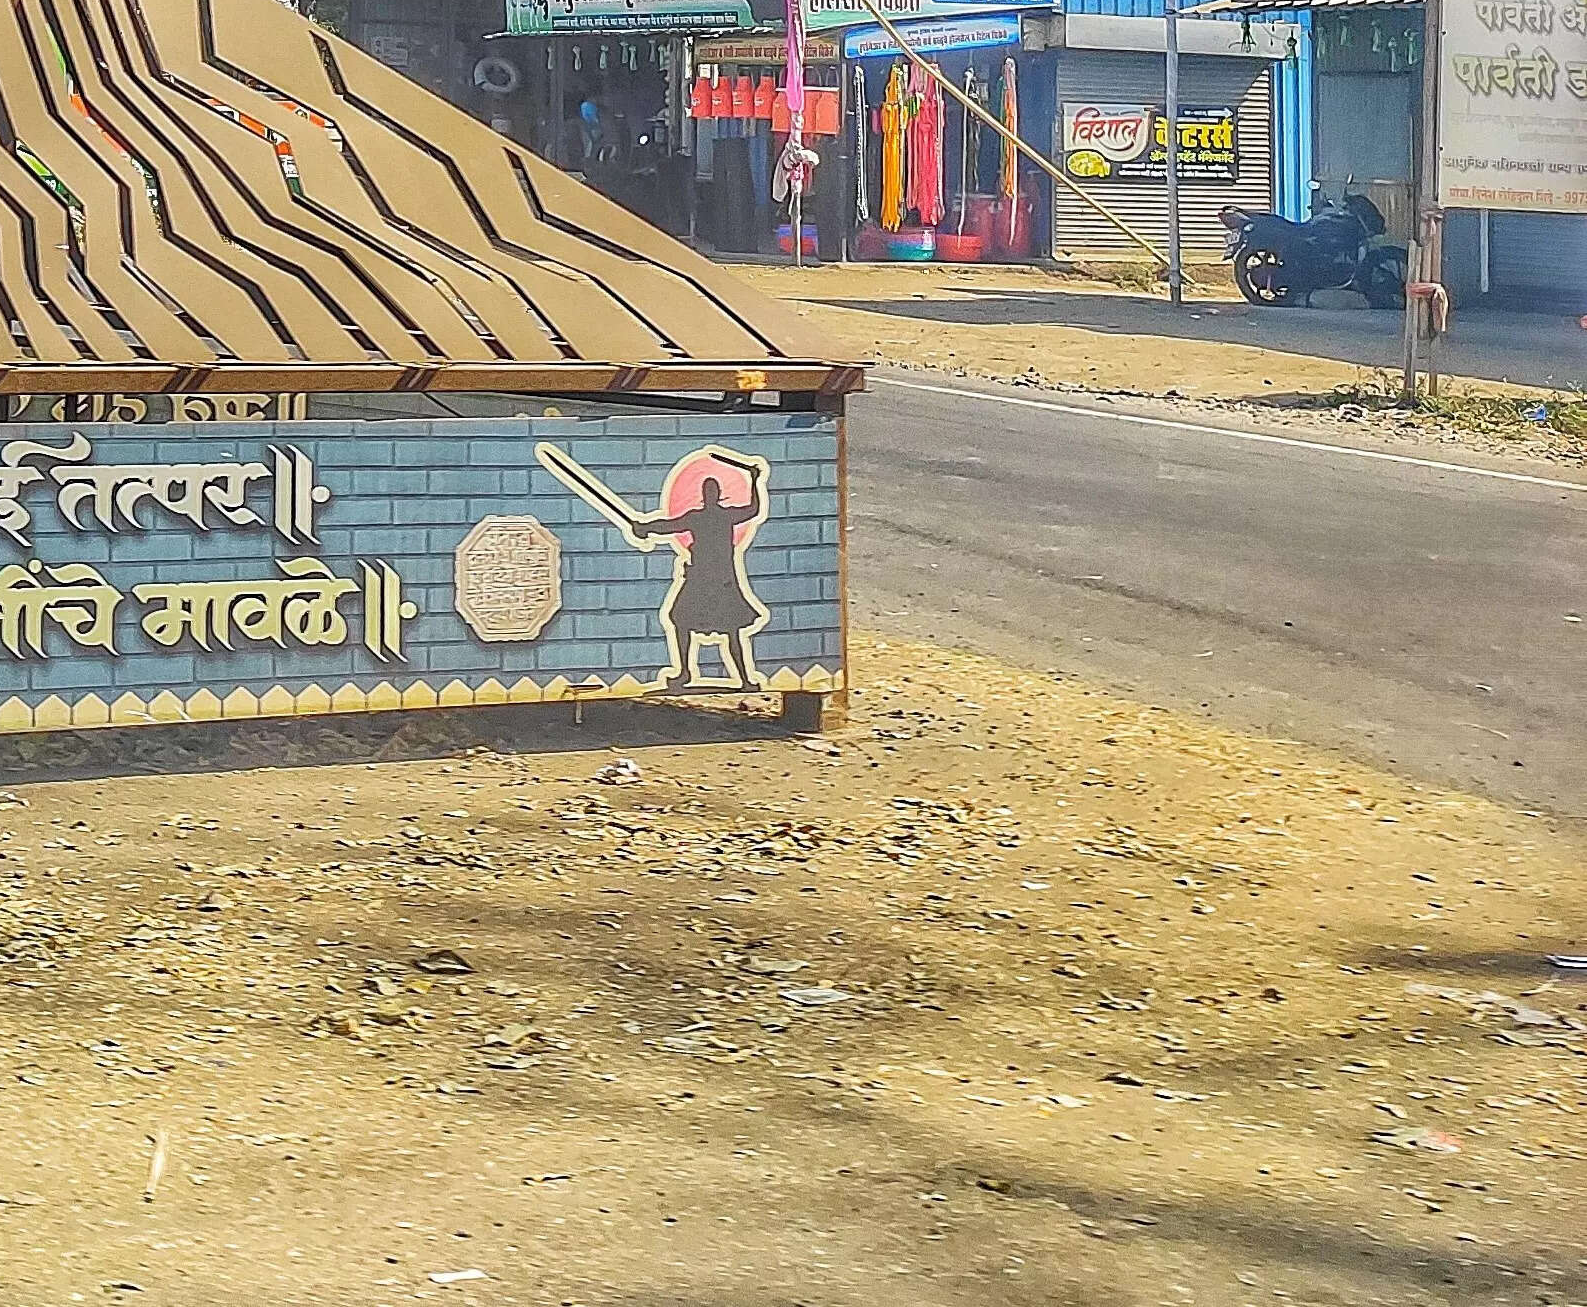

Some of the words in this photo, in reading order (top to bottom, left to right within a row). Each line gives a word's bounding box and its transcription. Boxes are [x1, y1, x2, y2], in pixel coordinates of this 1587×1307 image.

[1453, 42, 1559, 101] पार्वती
[1072, 107, 1143, 152] विशाल
[49, 461, 274, 533] तत्पर
[132, 557, 362, 652] मावळे
